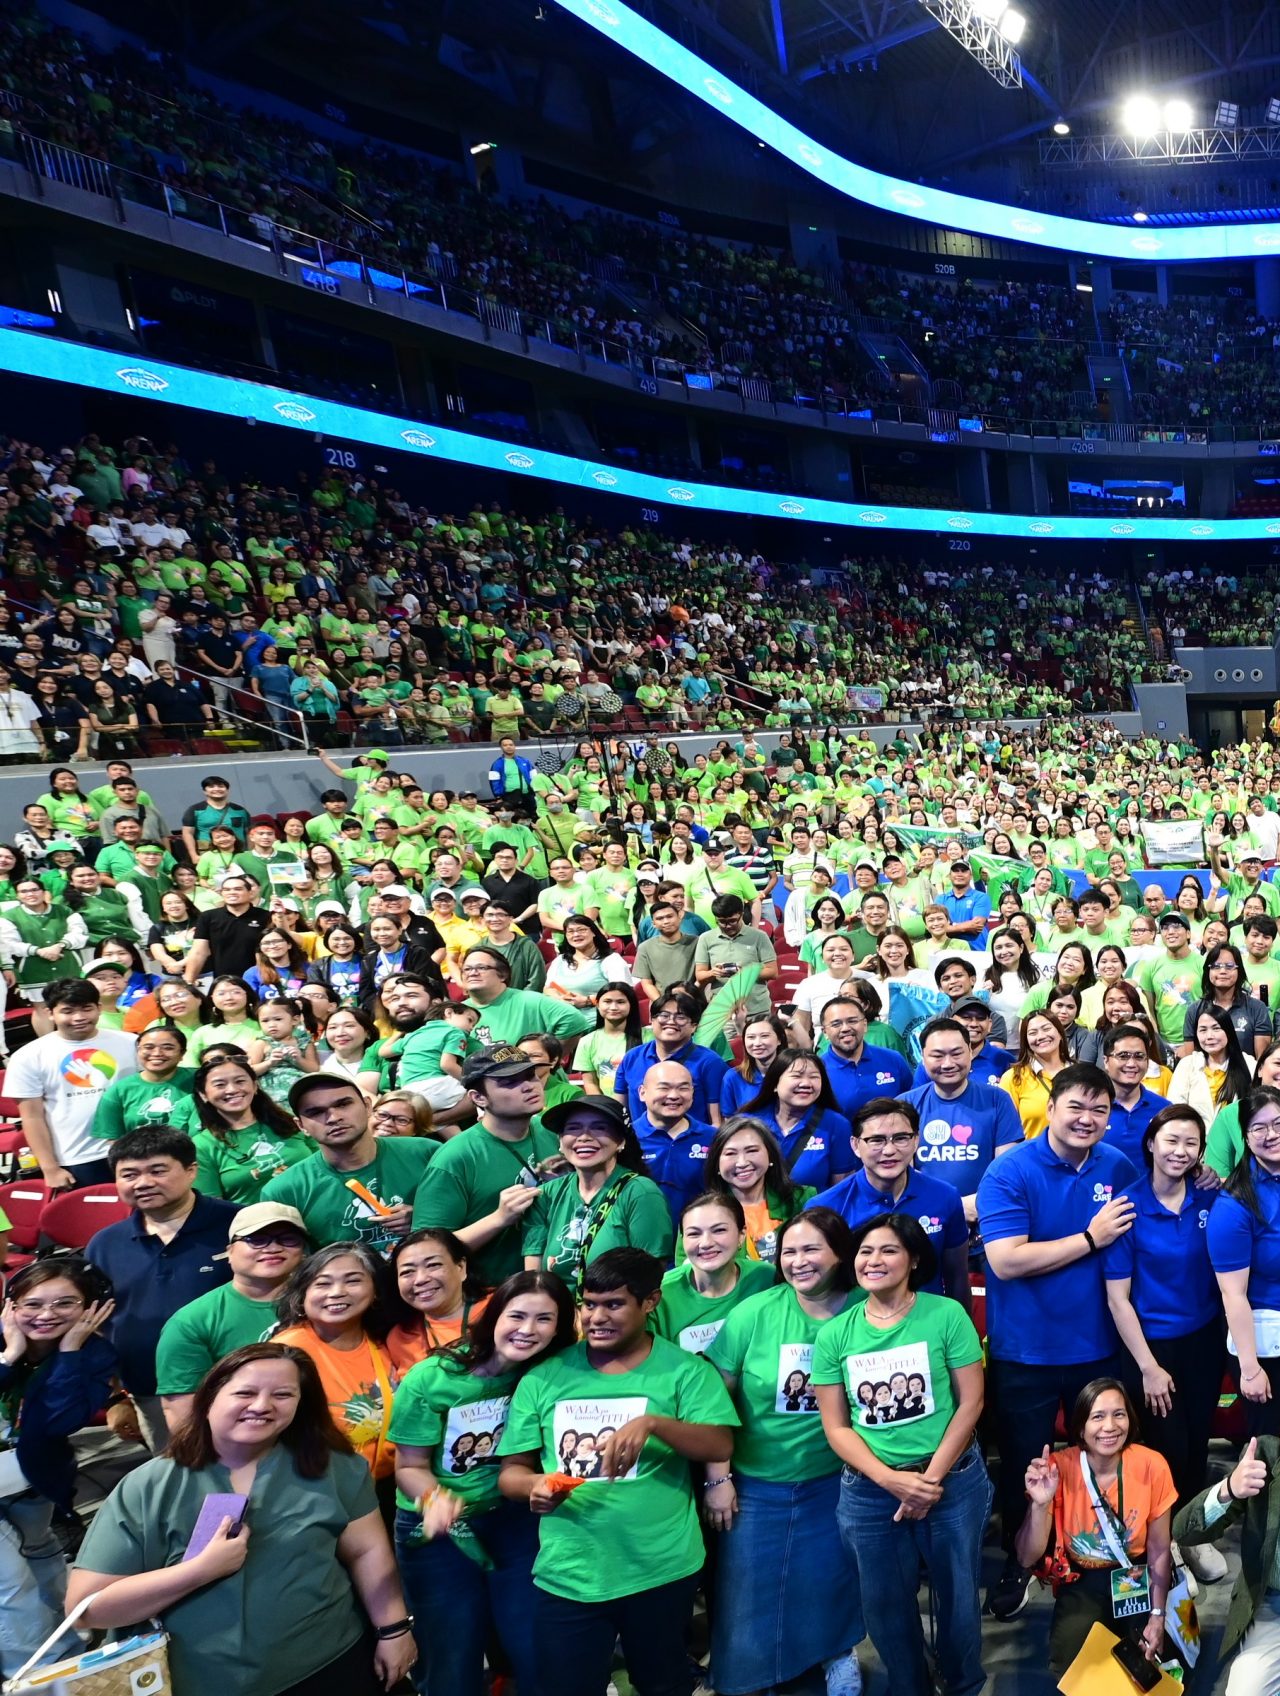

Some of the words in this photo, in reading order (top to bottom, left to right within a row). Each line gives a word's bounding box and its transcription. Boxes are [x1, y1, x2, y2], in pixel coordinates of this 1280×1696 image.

[934, 264, 956, 276] 520B
[124, 376, 165, 392] ARENA
[640, 378, 658, 395] 419
[279, 410, 314, 423] ARENA
[1071, 444, 1095, 454] 420B
[1260, 444, 1279, 455] 421
[326, 448, 356, 469] 218
[642, 508, 658, 523] 219
[949, 540, 971, 551] 220
[492, 1048, 511, 1064] SAN
[876, 1077, 896, 1086] CARES
[916, 1144, 980, 1163] CARES
[854, 1356, 887, 1369] WALA
[888, 1357, 918, 1372] TITLE
[460, 1405, 494, 1420] WALA
[565, 1405, 600, 1415] WALA
[574, 1414, 601, 1422] kaming
[1124, 1597, 1139, 1607] ALL
[1117, 1602, 1147, 1617] ACCESS
